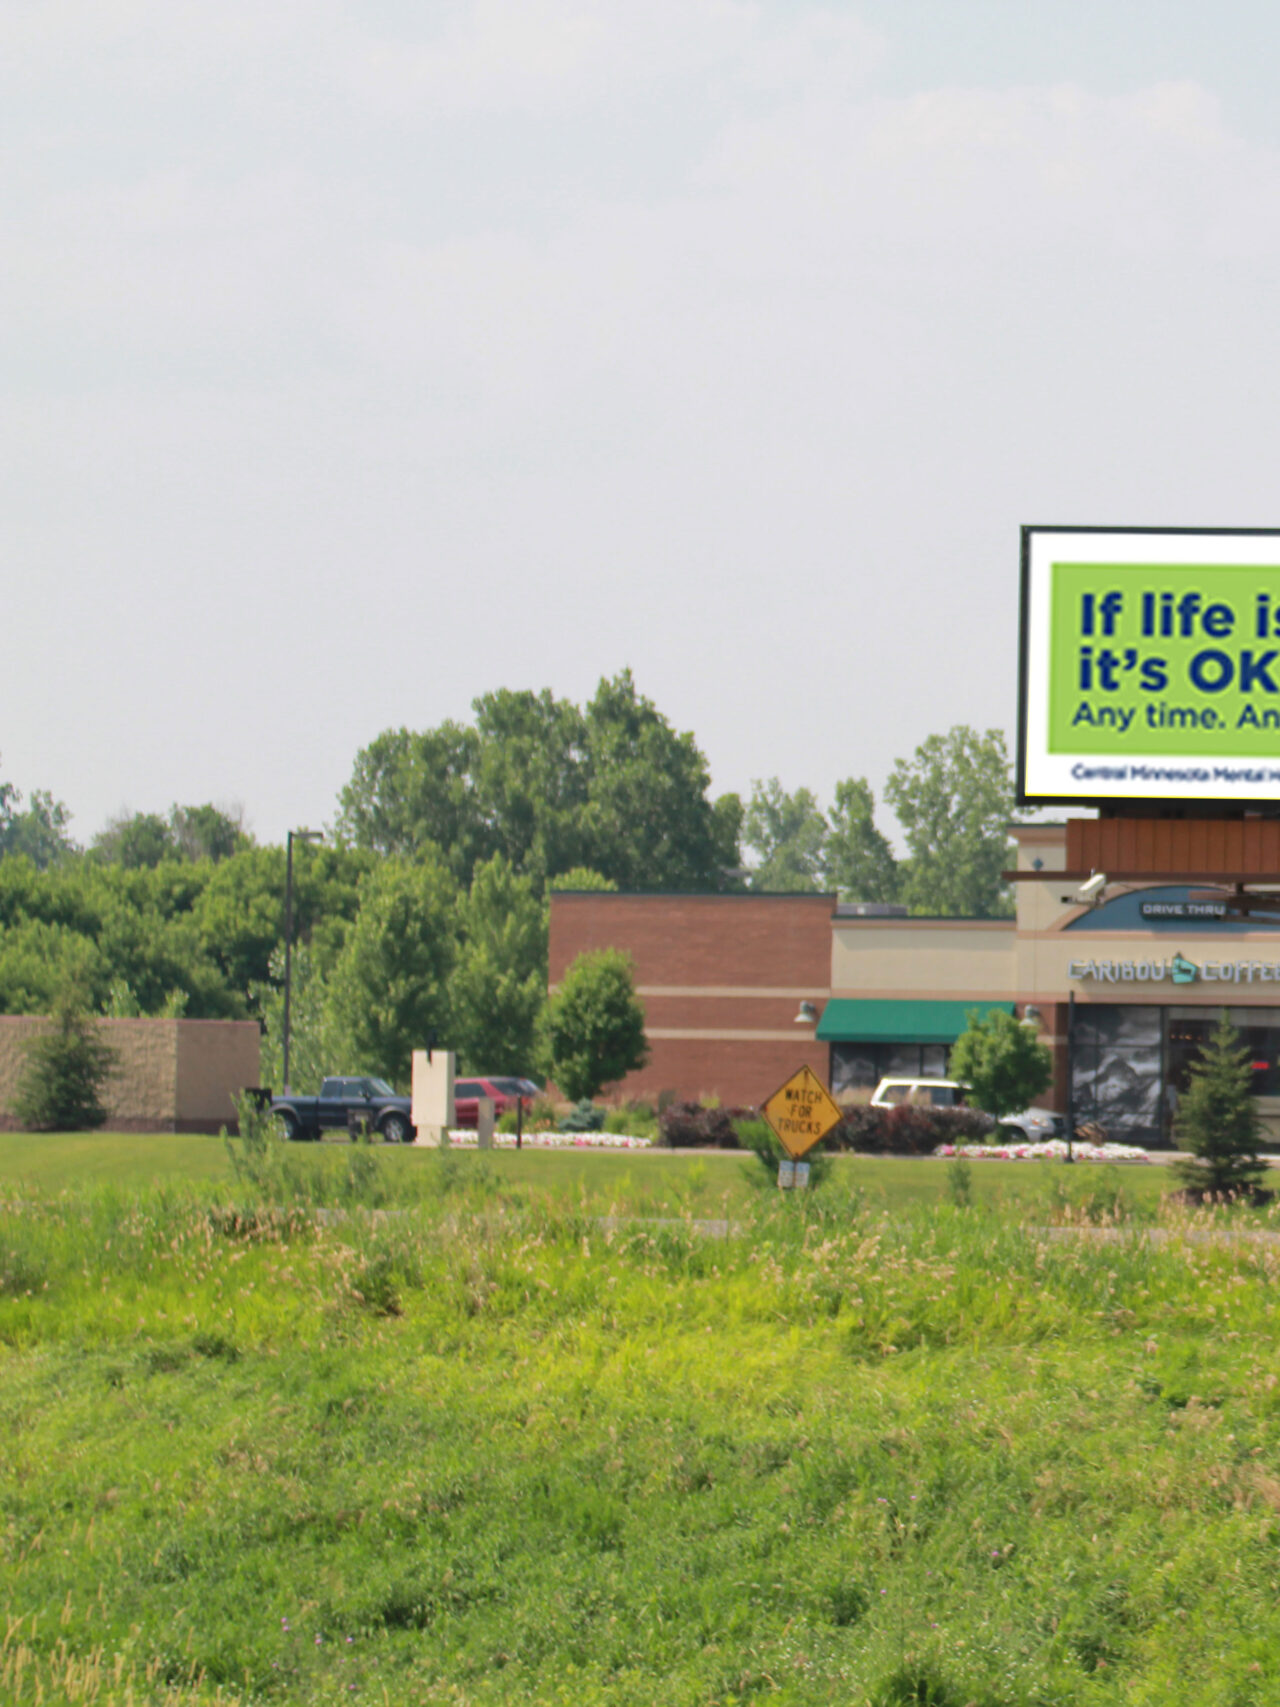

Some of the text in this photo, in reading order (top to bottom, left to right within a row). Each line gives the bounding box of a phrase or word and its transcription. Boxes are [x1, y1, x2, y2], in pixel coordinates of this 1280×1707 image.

[1081, 592, 1122, 637] If
[1141, 592, 1236, 638] life
[1079, 646, 1168, 692] it's
[1188, 649, 1280, 693] OK
[1072, 701, 1135, 733] Any
[1146, 703, 1226, 730] time.
[1071, 763, 1127, 780] Central
[1130, 765, 1209, 782] Minnesota
[1213, 766, 1266, 783] Mental
[1143, 904, 1225, 915] DRIVE THRU
[1067, 959, 1165, 983] CARIBOU
[785, 1088, 822, 1104] WATCH
[790, 1104, 812, 1118] FOR
[778, 1117, 822, 1135] TRUCKS
